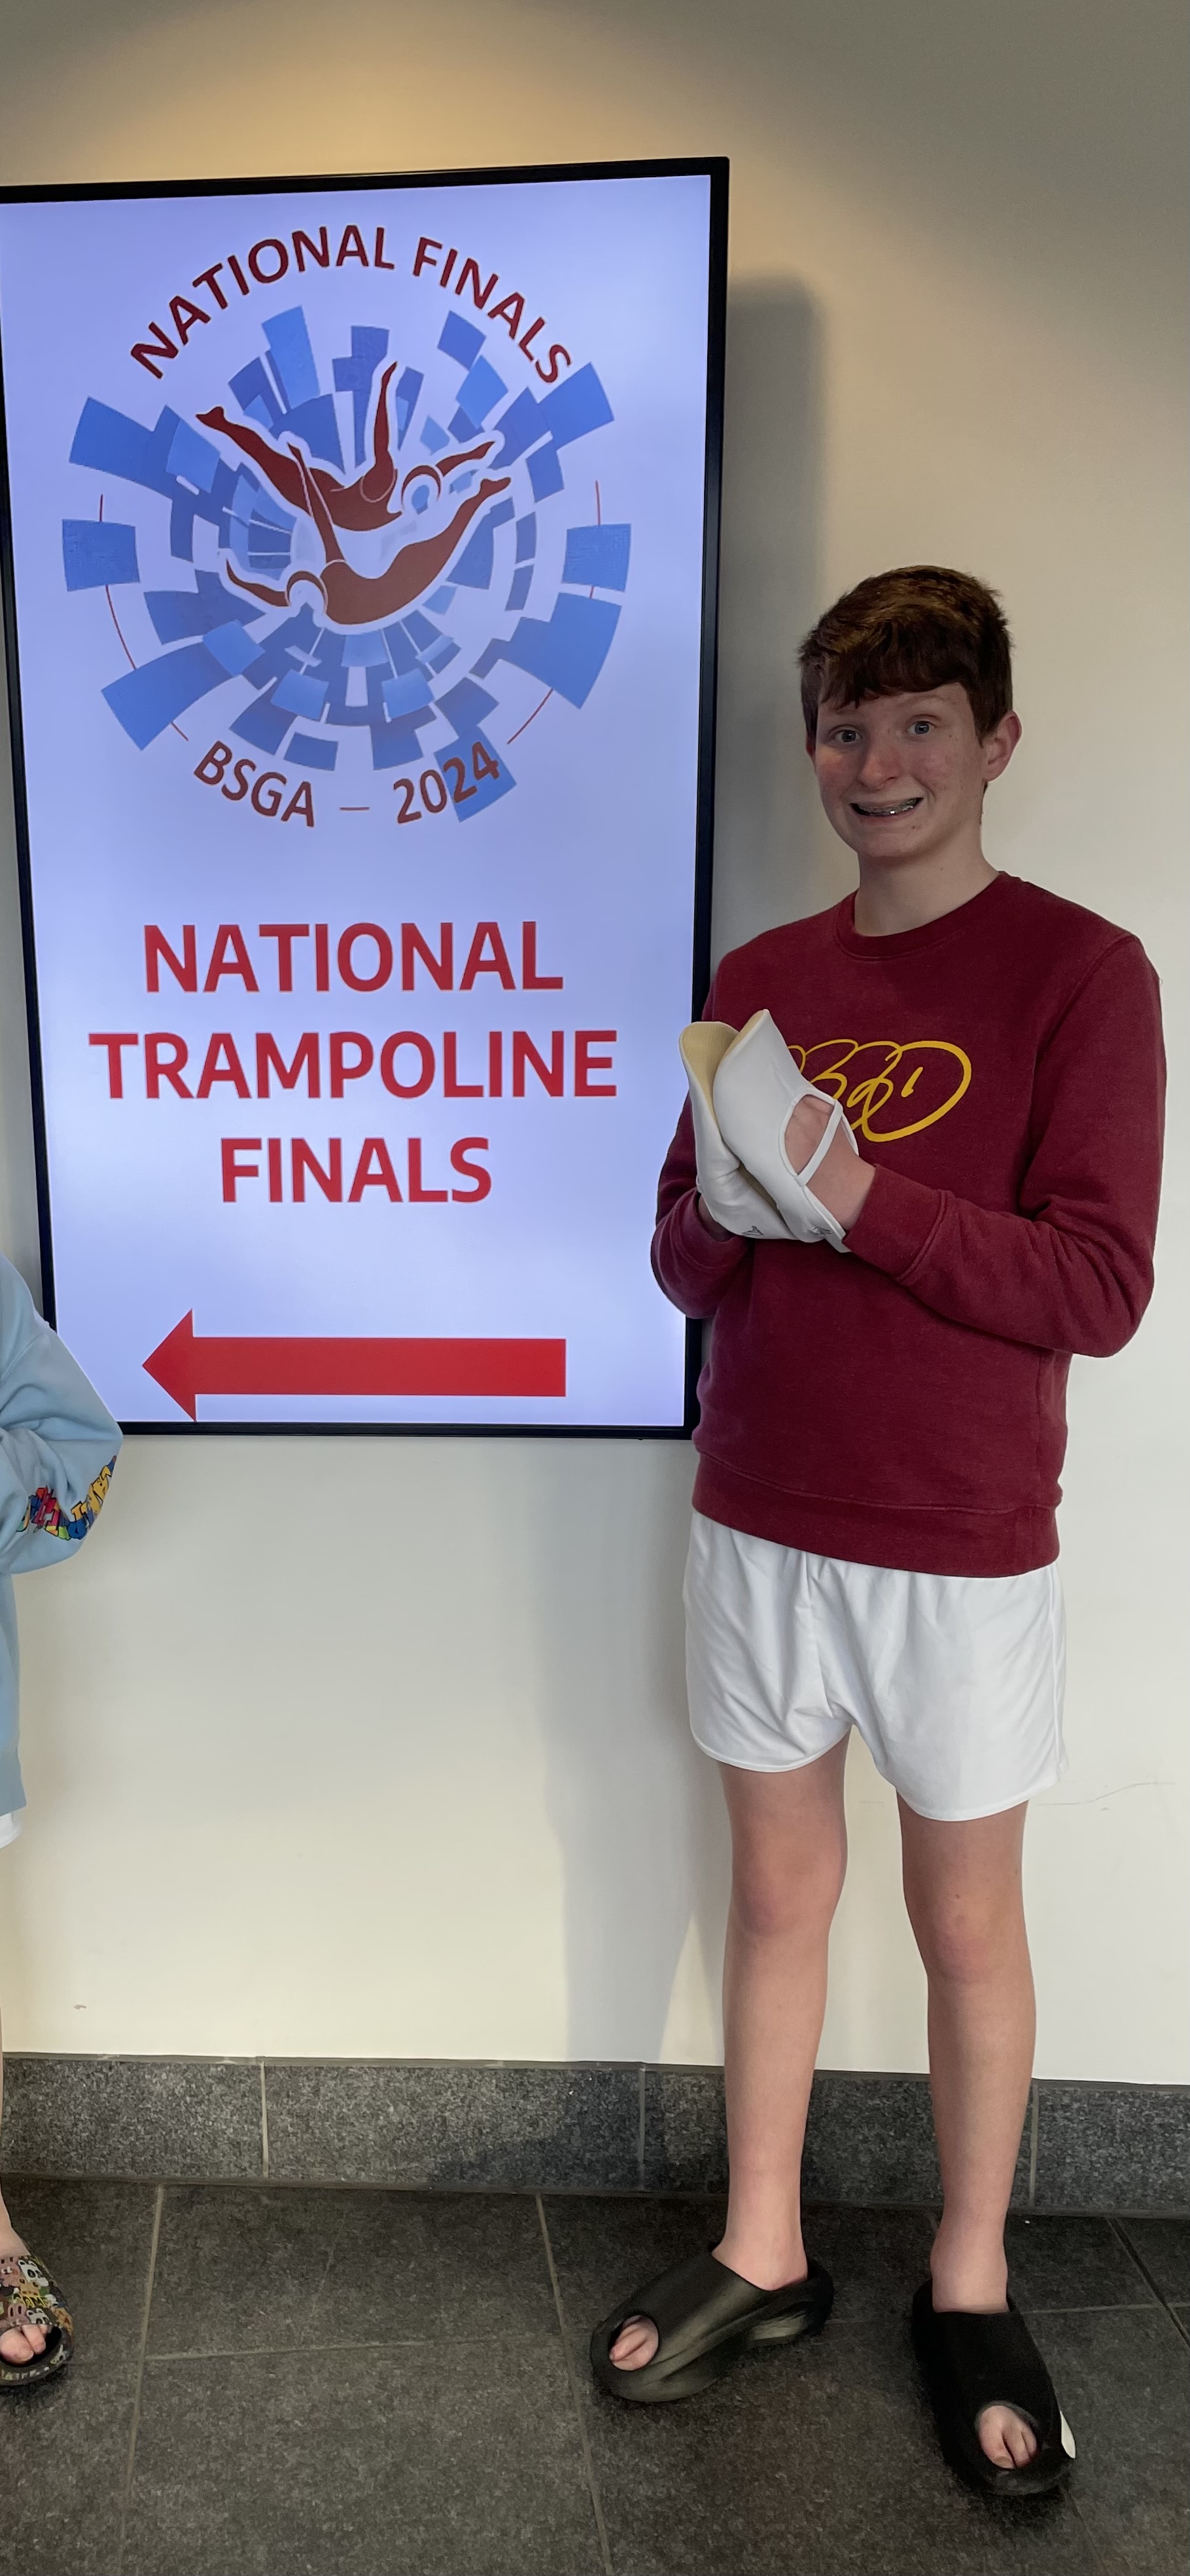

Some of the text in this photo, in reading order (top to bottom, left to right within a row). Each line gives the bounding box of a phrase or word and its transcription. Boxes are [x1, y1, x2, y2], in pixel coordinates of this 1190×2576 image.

[130, 224, 572, 385] NATIONAL FINALS
[194, 740, 315, 828] BSGA
[393, 741, 499, 824] 2024
[143, 921, 564, 994] NATIONAL
[88, 1029, 618, 1100] TRAMPOLINE
[220, 1137, 492, 1204] FINALS
